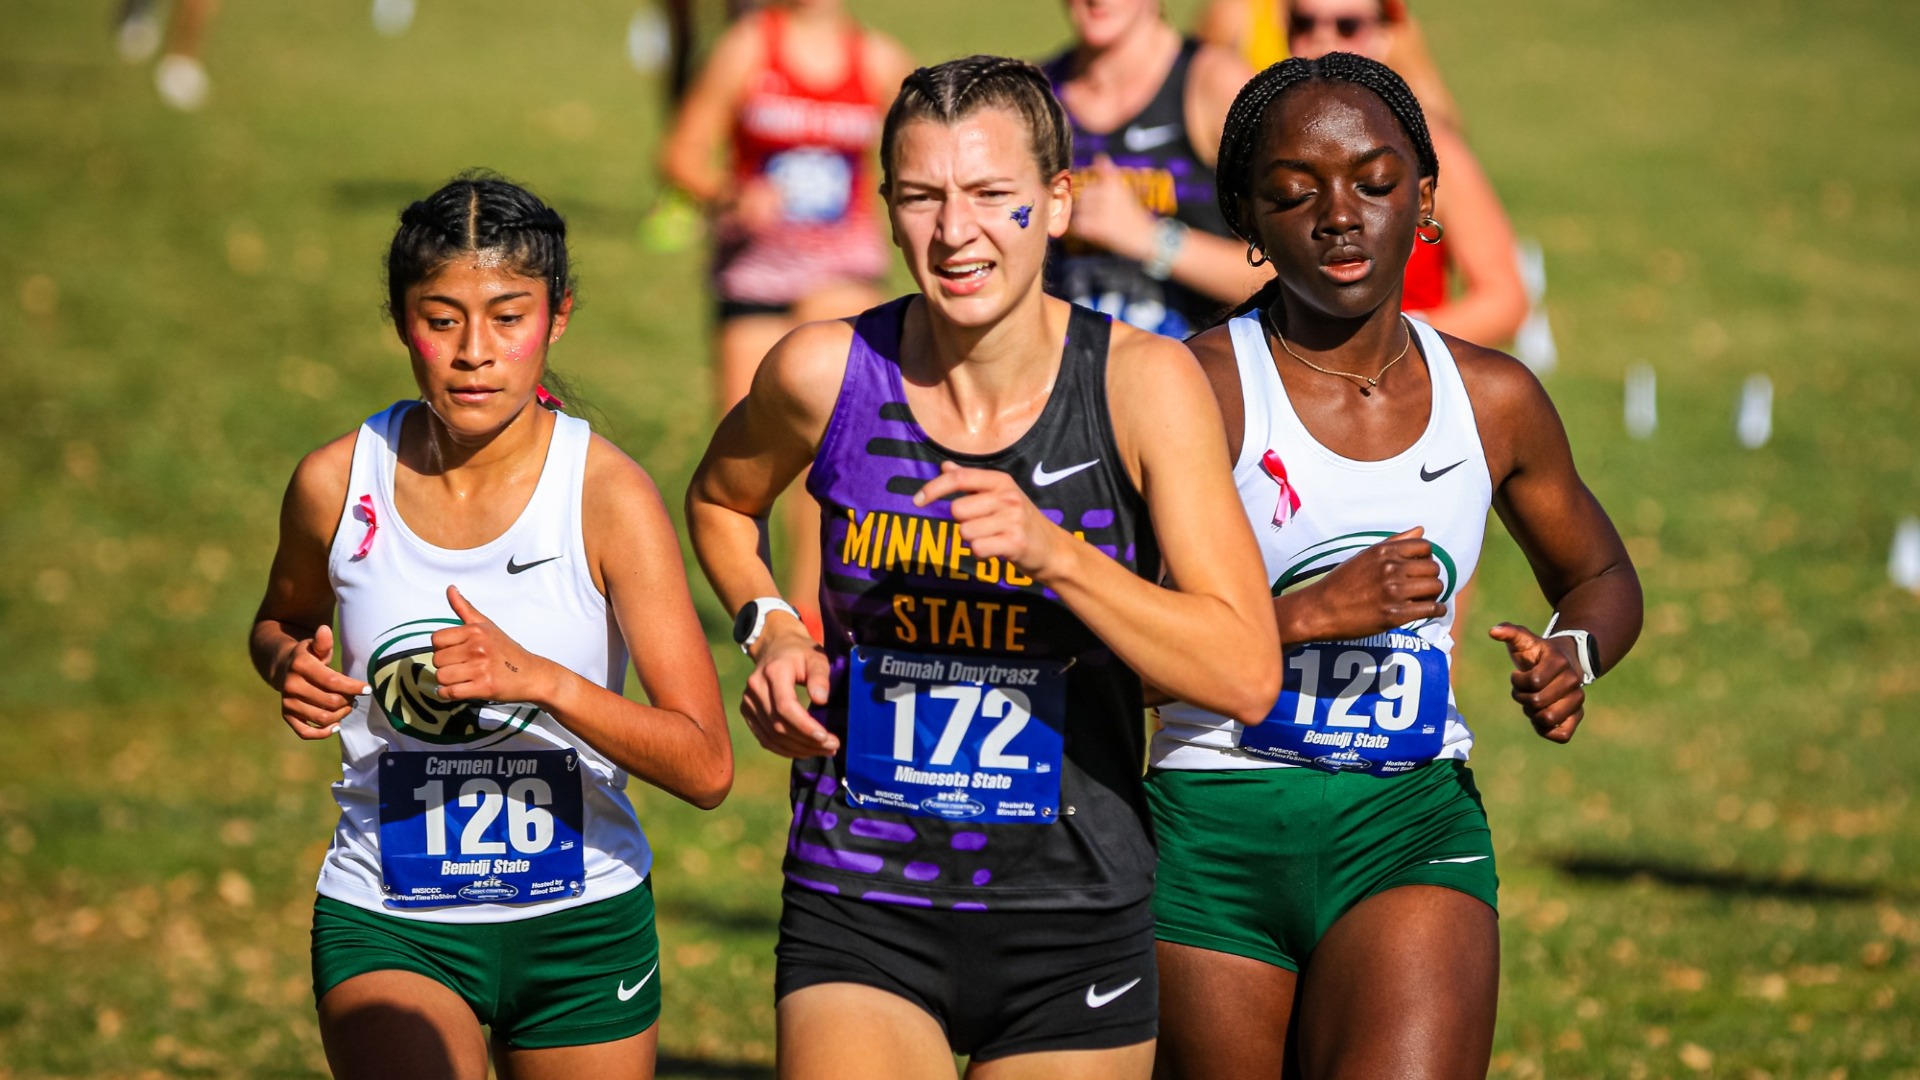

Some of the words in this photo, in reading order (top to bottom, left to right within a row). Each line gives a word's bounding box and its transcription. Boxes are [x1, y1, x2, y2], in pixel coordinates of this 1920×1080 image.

[893, 594, 1028, 651] STATE
[880, 655, 945, 680] Emmah
[948, 661, 1040, 685] Dmytrasz
[1289, 649, 1422, 731] 129
[884, 682, 1032, 770] 172
[1303, 730, 1352, 748] Bemidji
[1355, 732, 1389, 749] State
[425, 756, 492, 776] Carmen
[497, 756, 538, 778] Lyon
[894, 765, 970, 788] Minnesota
[971, 772, 1012, 790] State
[413, 778, 554, 855] 126
[441, 860, 491, 877] Bemidji
[493, 859, 530, 874] State
